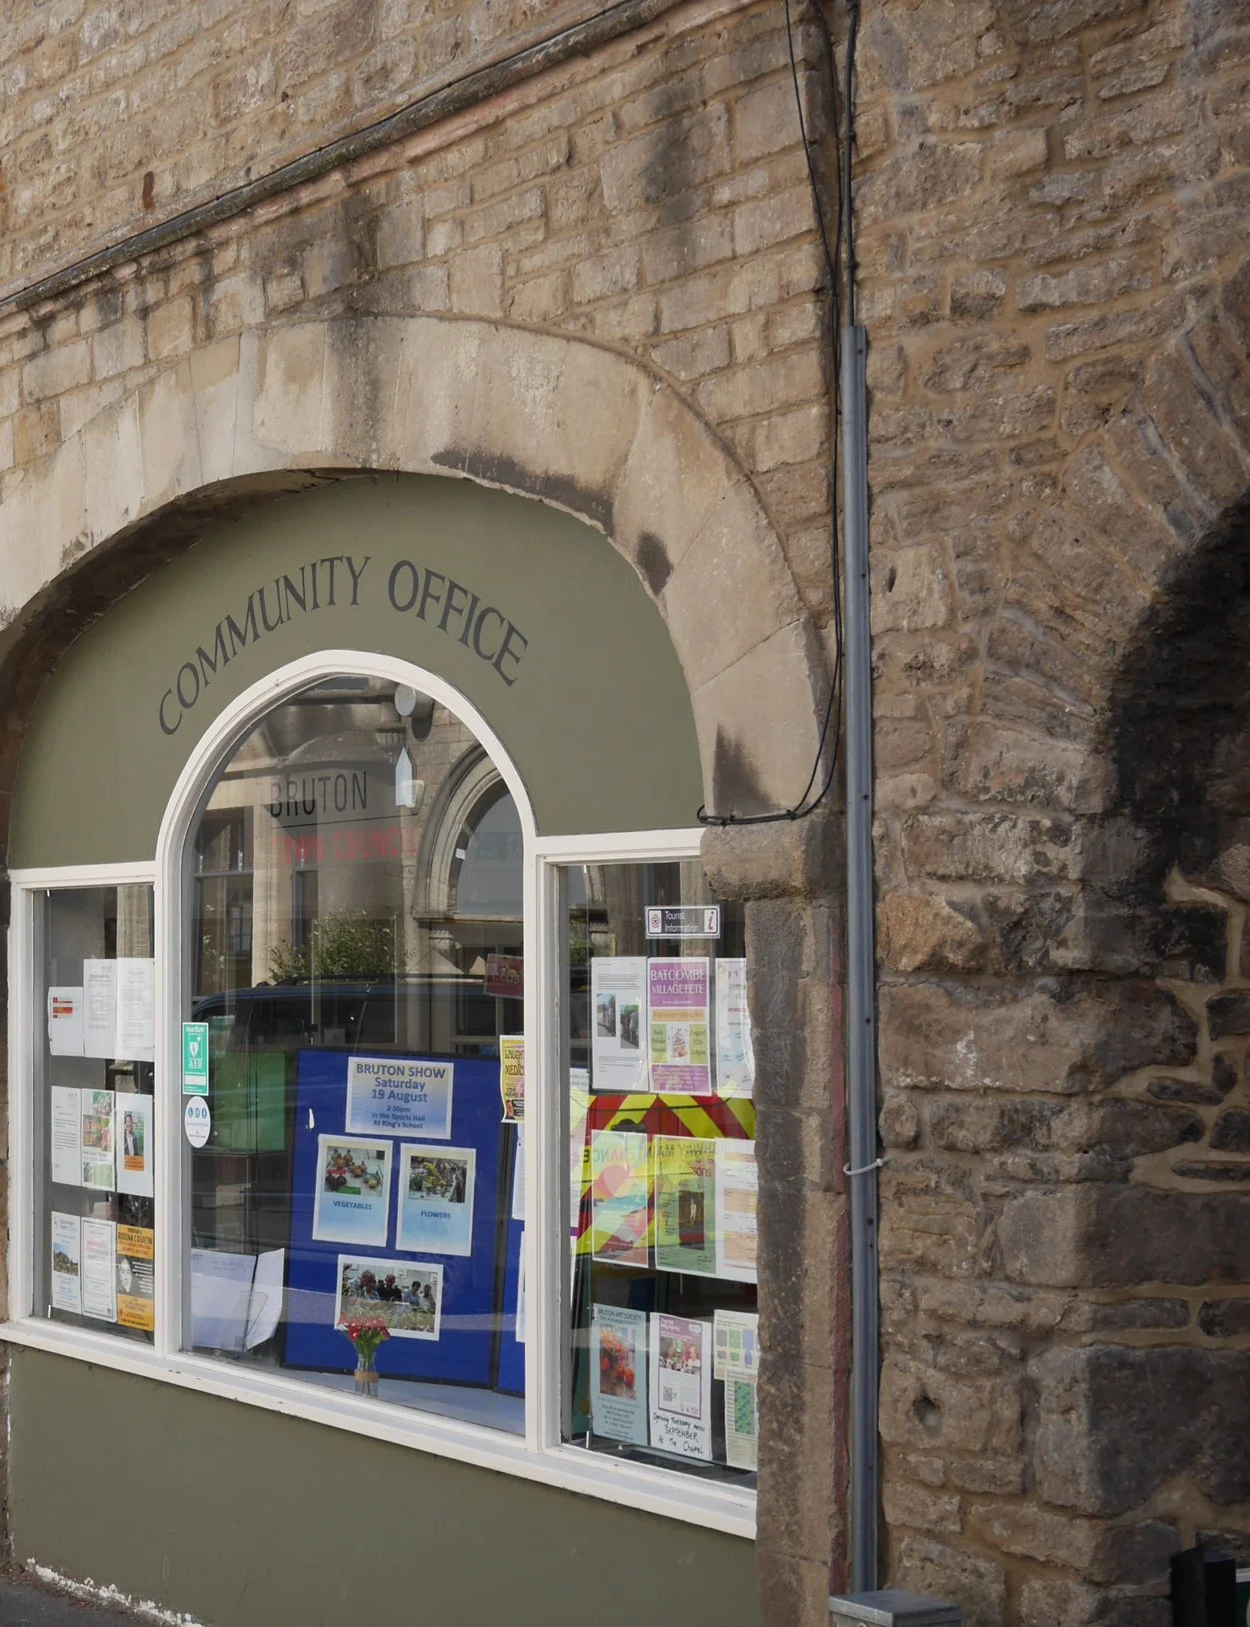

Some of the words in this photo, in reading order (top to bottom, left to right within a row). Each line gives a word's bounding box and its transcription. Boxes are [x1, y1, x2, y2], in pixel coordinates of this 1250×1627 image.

[159, 554, 371, 735] COMMUNITY
[388, 560, 530, 687] OFFICE
[270, 771, 367, 818] BRUTON
[271, 833, 325, 864] TOWN
[335, 823, 418, 862] COUNCIL
[664, 910, 686, 920] Tourist
[664, 923, 699, 932] Information
[650, 969, 706, 981] BATCOMBE
[652, 984, 684, 994] VILLAGE
[356, 1063, 405, 1076] BRUTON
[408, 1066, 446, 1079] SHOW
[374, 1077, 426, 1092] Saturday
[371, 1089, 385, 1100] 19
[388, 1090, 428, 1104] August
[387, 1105, 411, 1113] 2:30pm
[391, 1113, 412, 1122] Sports
[382, 1120, 401, 1129] King's
[402, 1121, 424, 1129] School
[333, 1200, 372, 1211] VEGETABLES
[420, 1210, 452, 1219] FLOWERS
